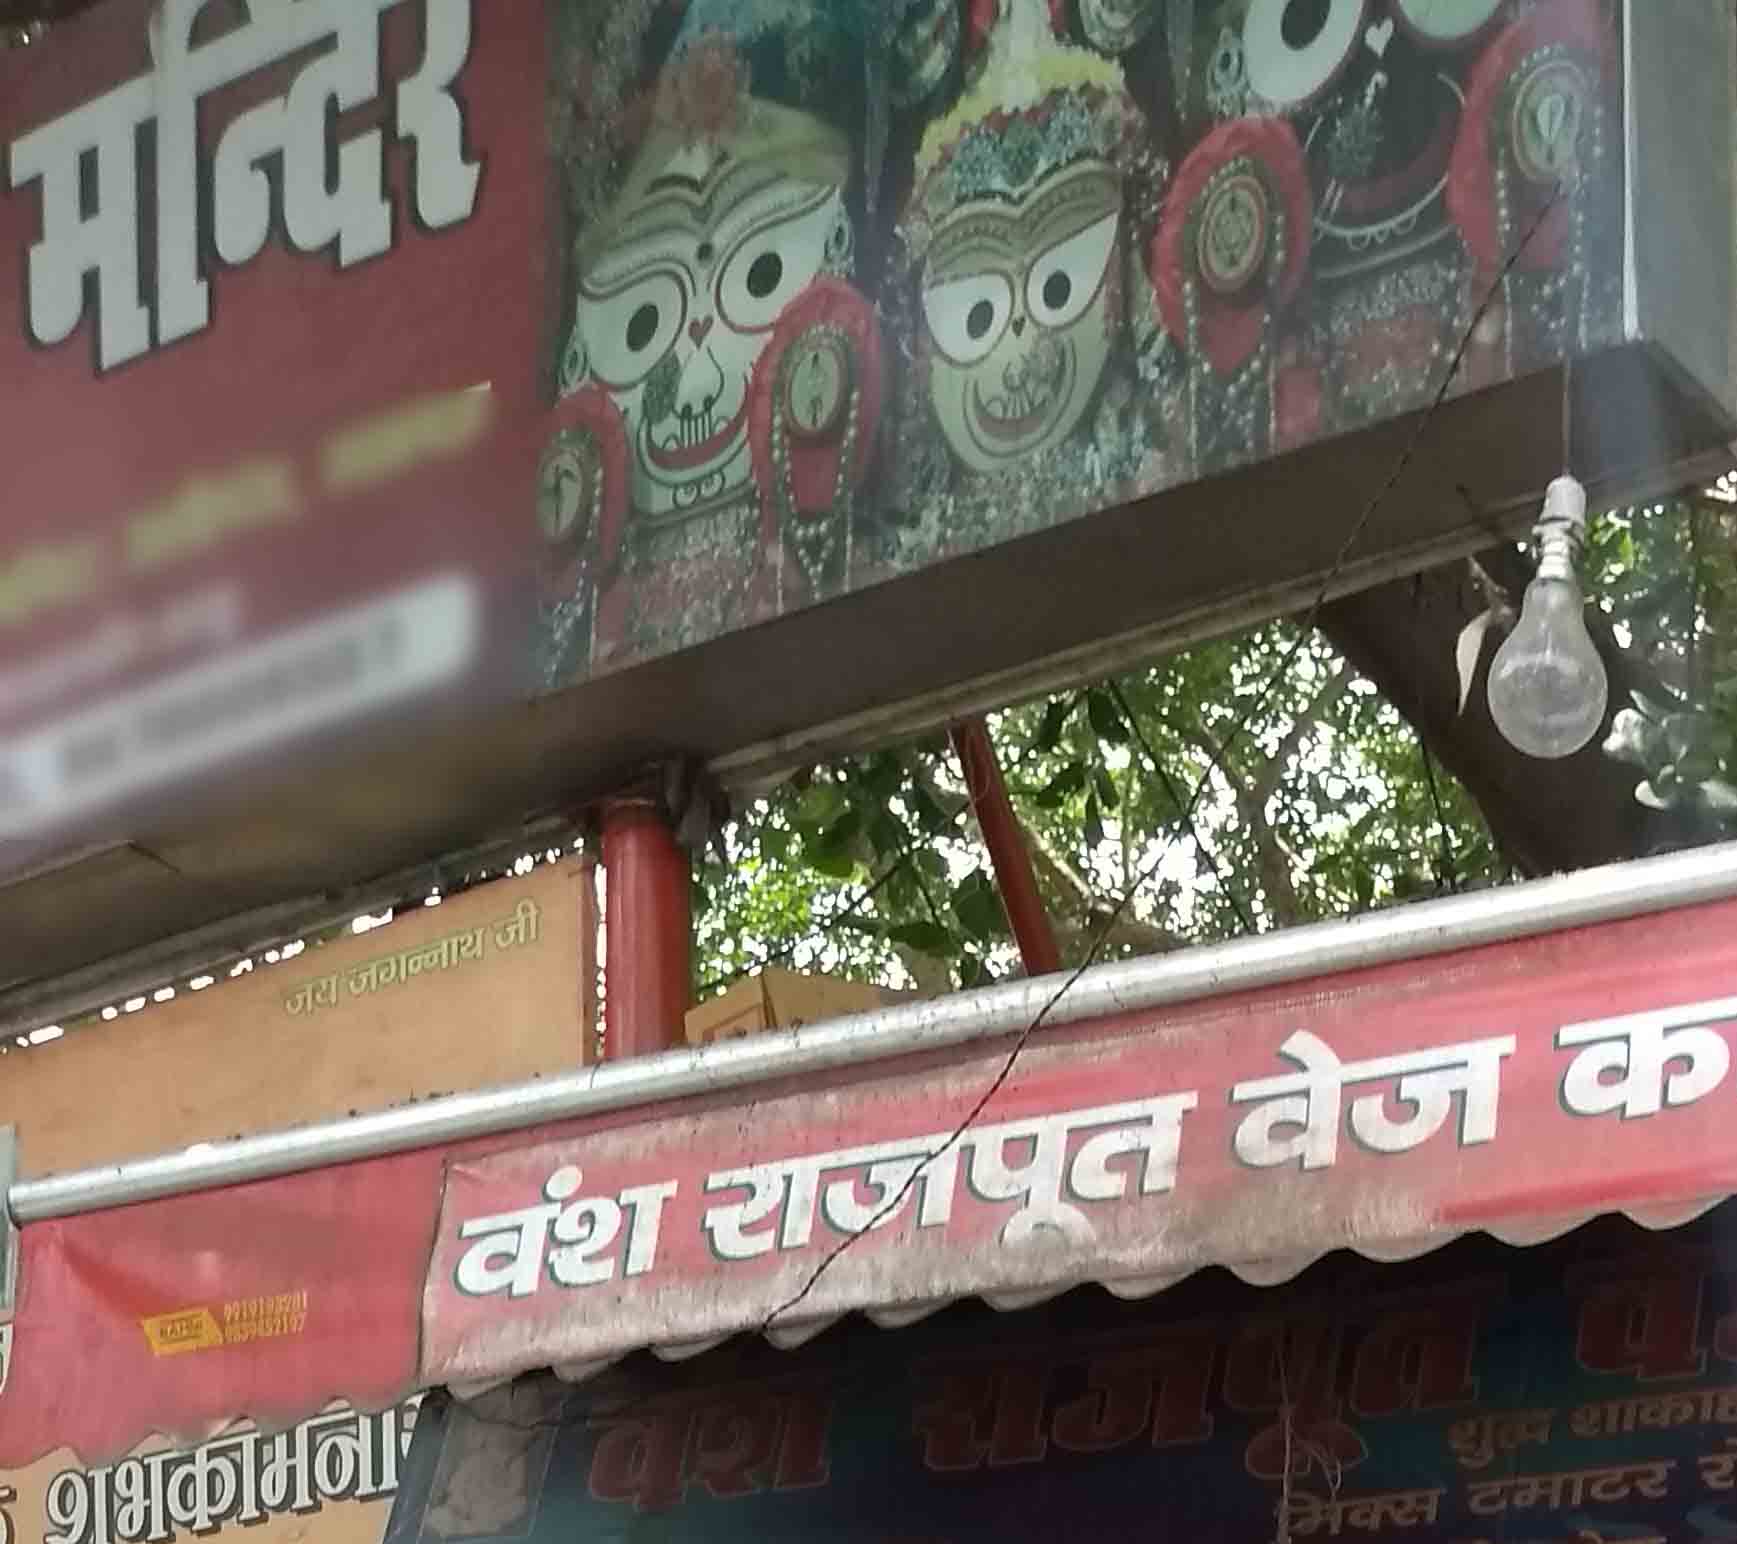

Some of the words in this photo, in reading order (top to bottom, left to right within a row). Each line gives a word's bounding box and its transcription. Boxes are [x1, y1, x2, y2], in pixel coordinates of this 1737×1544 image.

[284, 968, 337, 1016] जय
[349, 927, 485, 998] जगन्नाथ
[494, 897, 541, 950] जी
[453, 1165, 678, 1298] वंश
[704, 1091, 1197, 1262] राजपूत
[1228, 1030, 1514, 1170] वेज
[1467, 1458, 1677, 1515] टमाटर
